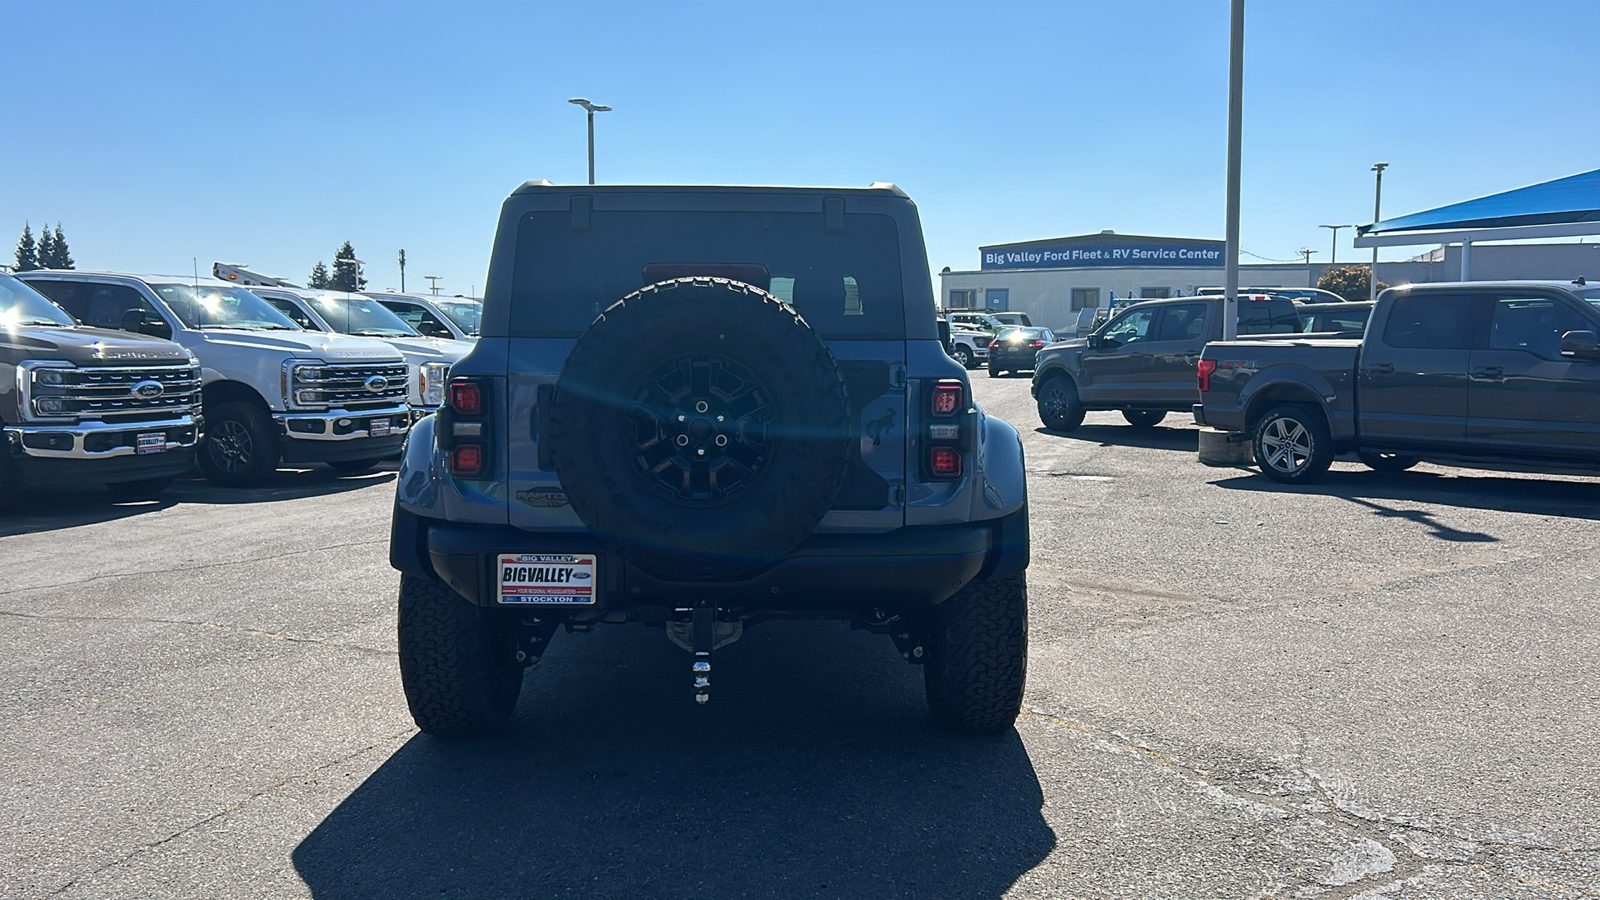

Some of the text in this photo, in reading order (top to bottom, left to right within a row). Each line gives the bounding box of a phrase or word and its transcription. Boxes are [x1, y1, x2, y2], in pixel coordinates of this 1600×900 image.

[986, 253, 1004, 265] Big
[1006, 252, 1042, 263] Valley
[1044, 250, 1070, 261] Ford
[1072, 249, 1102, 260] Fleet
[1113, 249, 1130, 259] RV
[1132, 248, 1176, 259] Service
[1179, 248, 1219, 259] Center
[517, 491, 565, 501] RAPTO
[503, 567, 573, 583] BIGVALLEY
